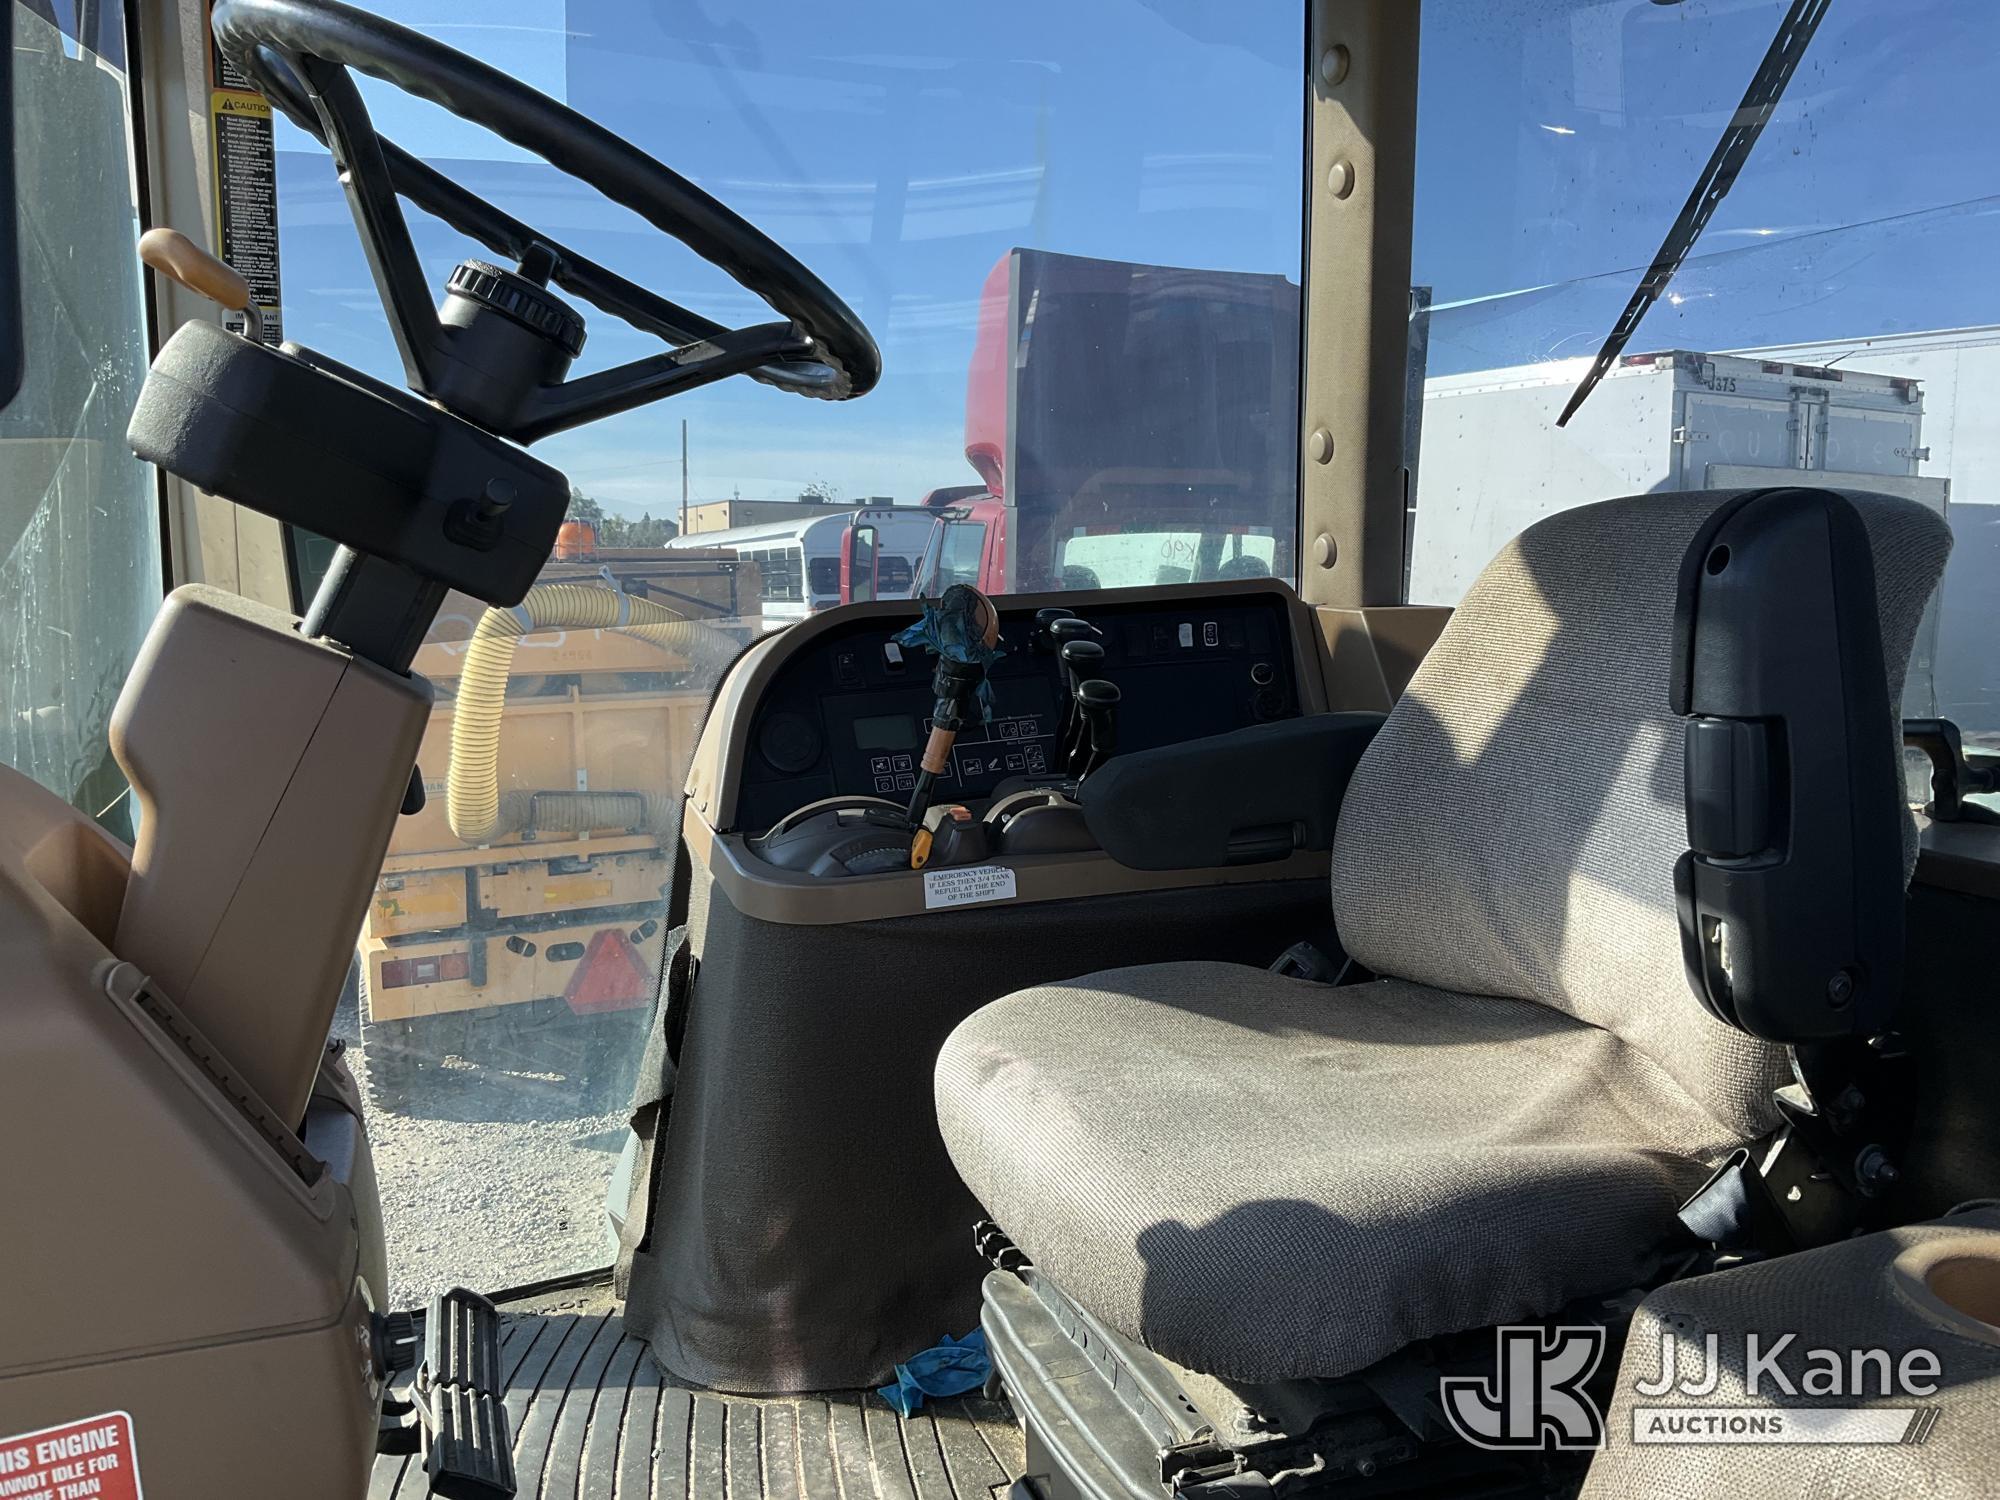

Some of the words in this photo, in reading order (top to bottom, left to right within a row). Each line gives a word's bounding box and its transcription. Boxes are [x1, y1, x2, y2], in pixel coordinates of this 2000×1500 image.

[234, 101, 270, 112] CAUTION
[933, 870, 977, 881] EMERGENCY
[938, 879, 956, 888] LESS
[957, 877, 976, 886] THEN
[978, 875, 990, 883] 3/4
[992, 872, 1010, 880] TANK
[934, 886, 962, 896] REFUEL
[974, 882, 989, 890] THE
[990, 880, 1006, 888] END
[976, 888, 996, 898] SHIFT
[36, 1424, 120, 1465] ENGINE
[52, 1462, 86, 1484] IDLE
[88, 1453, 119, 1474] FOR
[57, 1478, 102, 1500] THAN
